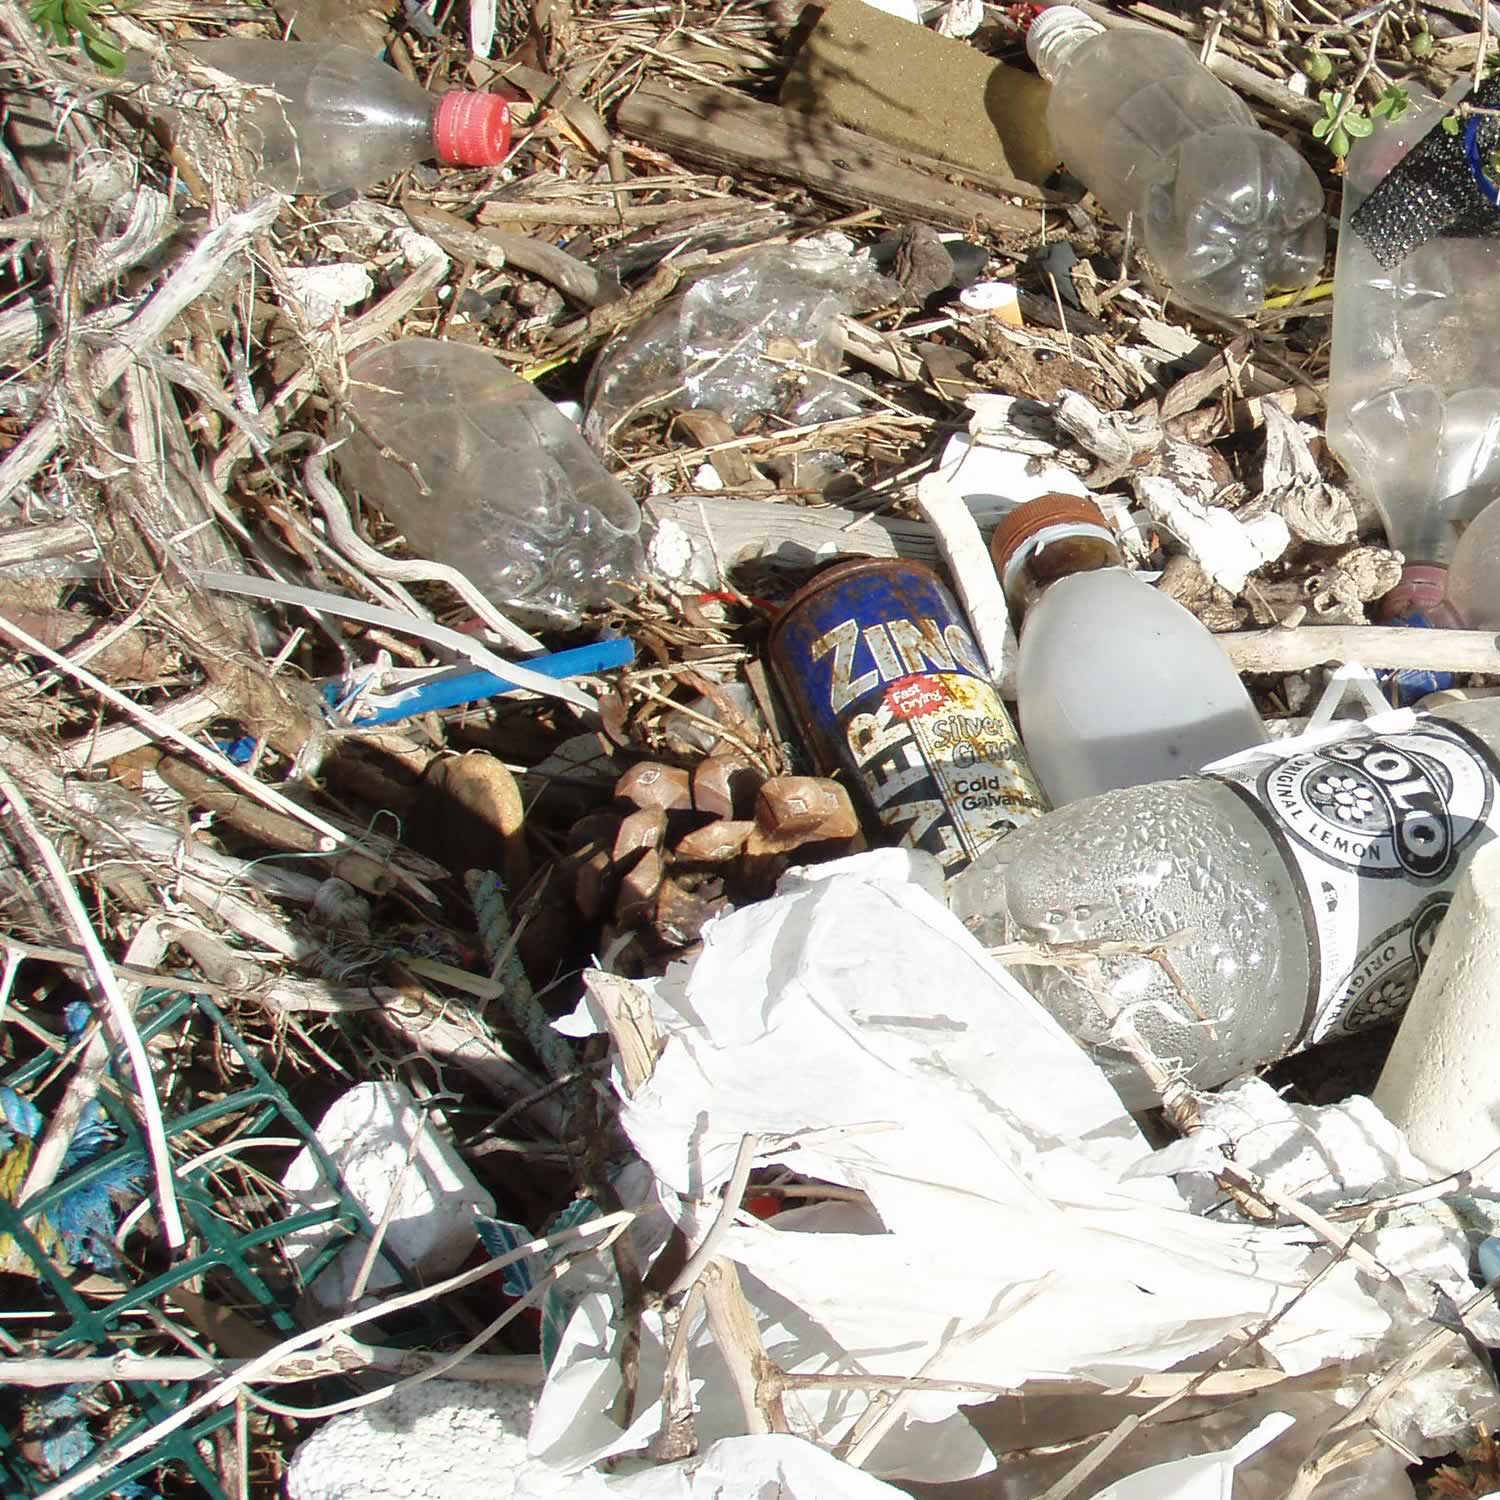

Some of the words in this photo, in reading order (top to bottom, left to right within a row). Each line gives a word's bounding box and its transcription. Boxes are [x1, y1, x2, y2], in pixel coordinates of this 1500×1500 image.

[892, 683, 920, 704] Fast
[900, 689, 943, 713] Drying
[932, 714, 1004, 749] Silver
[954, 776, 999, 795] Cold
[1326, 742, 1448, 858] SOLO
[1276, 759, 1311, 820] ORIGINAL
[1308, 823, 1381, 861] LEMON
